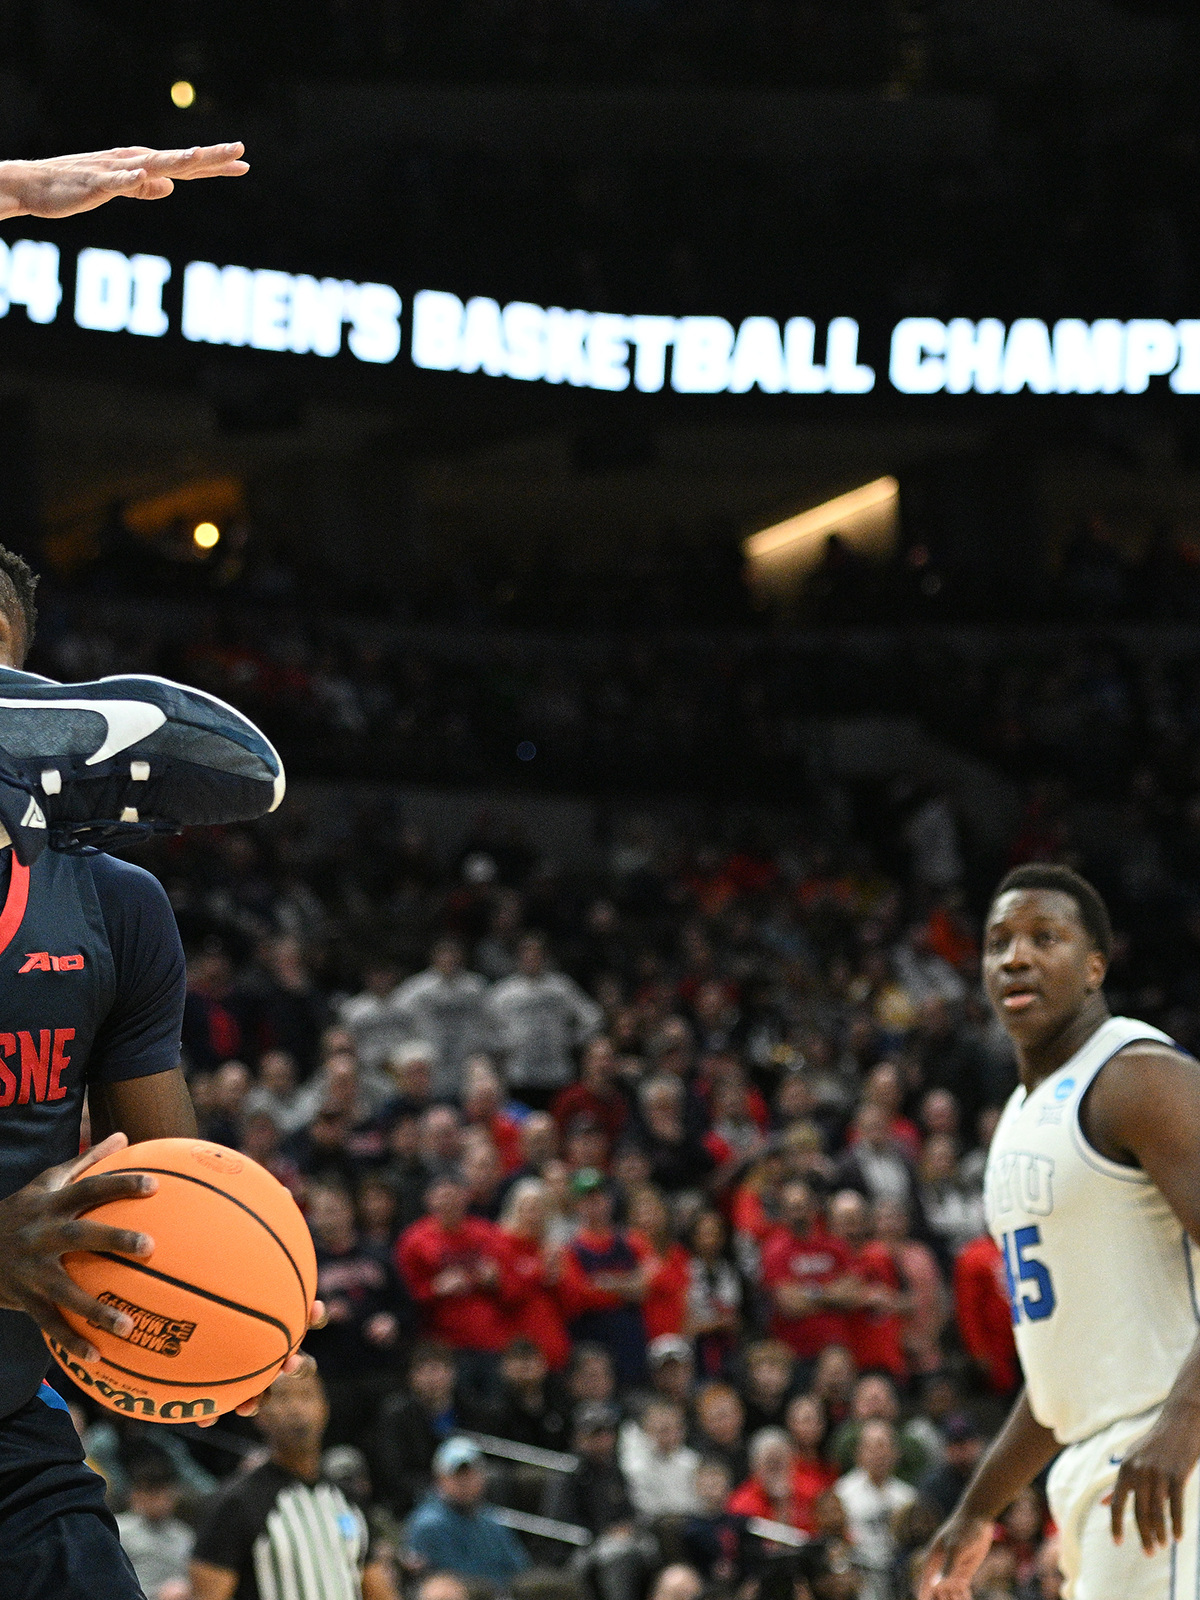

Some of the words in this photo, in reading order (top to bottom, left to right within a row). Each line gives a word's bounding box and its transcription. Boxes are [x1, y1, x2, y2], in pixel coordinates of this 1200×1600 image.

[74, 246, 172, 338] DI
[181, 269, 403, 364] MEN'S
[411, 289, 876, 394] BASKETBALL
[888, 317, 1200, 395] CHAMPI
[987, 1150, 1055, 1217] YU
